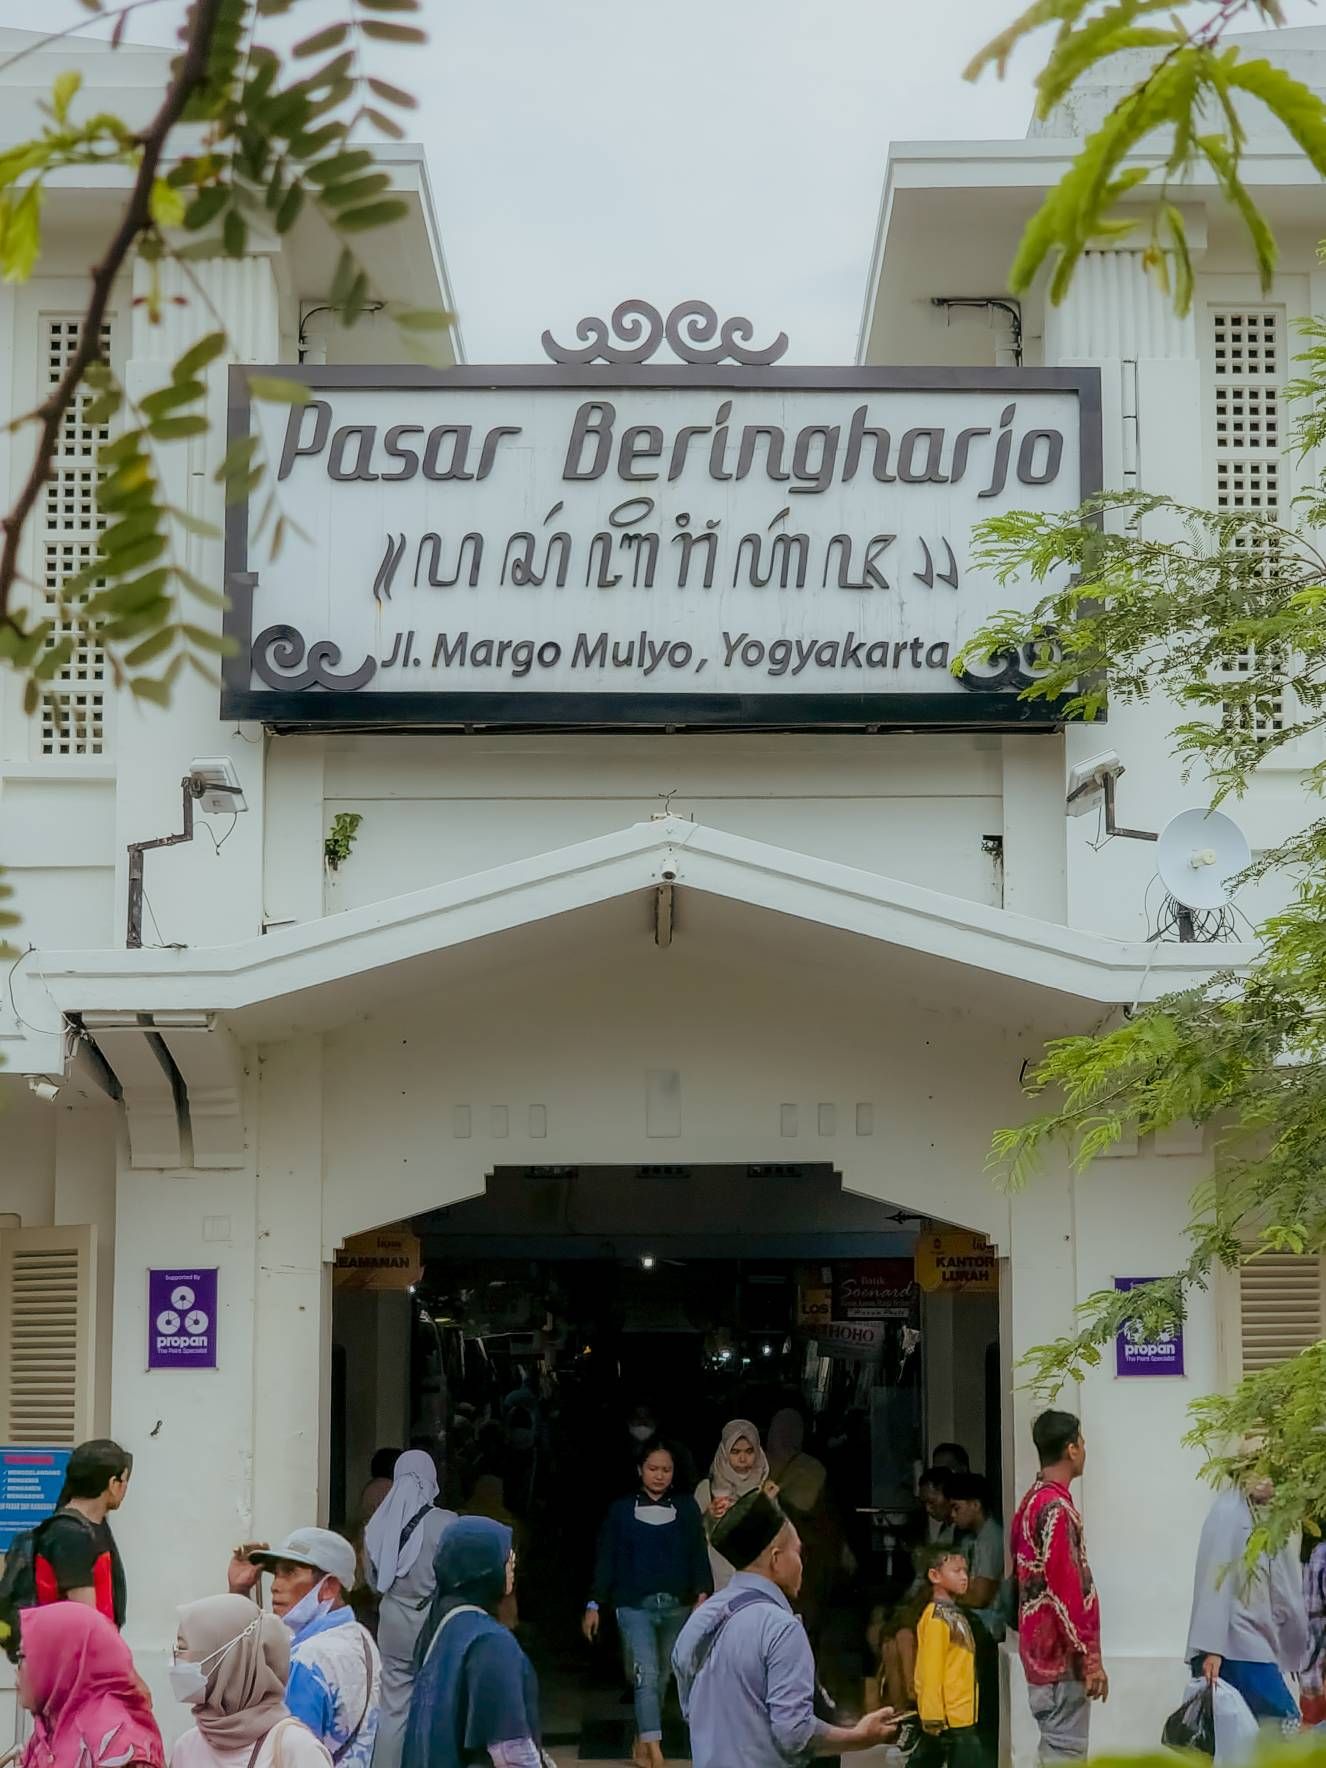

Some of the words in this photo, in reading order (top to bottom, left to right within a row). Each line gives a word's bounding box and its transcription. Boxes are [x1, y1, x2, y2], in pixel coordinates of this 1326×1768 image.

[278, 400, 522, 481] Pasar
[563, 400, 1064, 498] Beringharjo
[380, 632, 421, 668] Jl.
[432, 632, 561, 677] Margo
[571, 632, 707, 677] Mulyo,
[722, 632, 950, 677] Yogyakarta
[935, 1257, 995, 1268] KANTOR
[942, 1270, 989, 1281] LURAH
[802, 1303, 829, 1315] LOS
[157, 1336, 208, 1348] propan
[1125, 1344, 1175, 1356] propan
